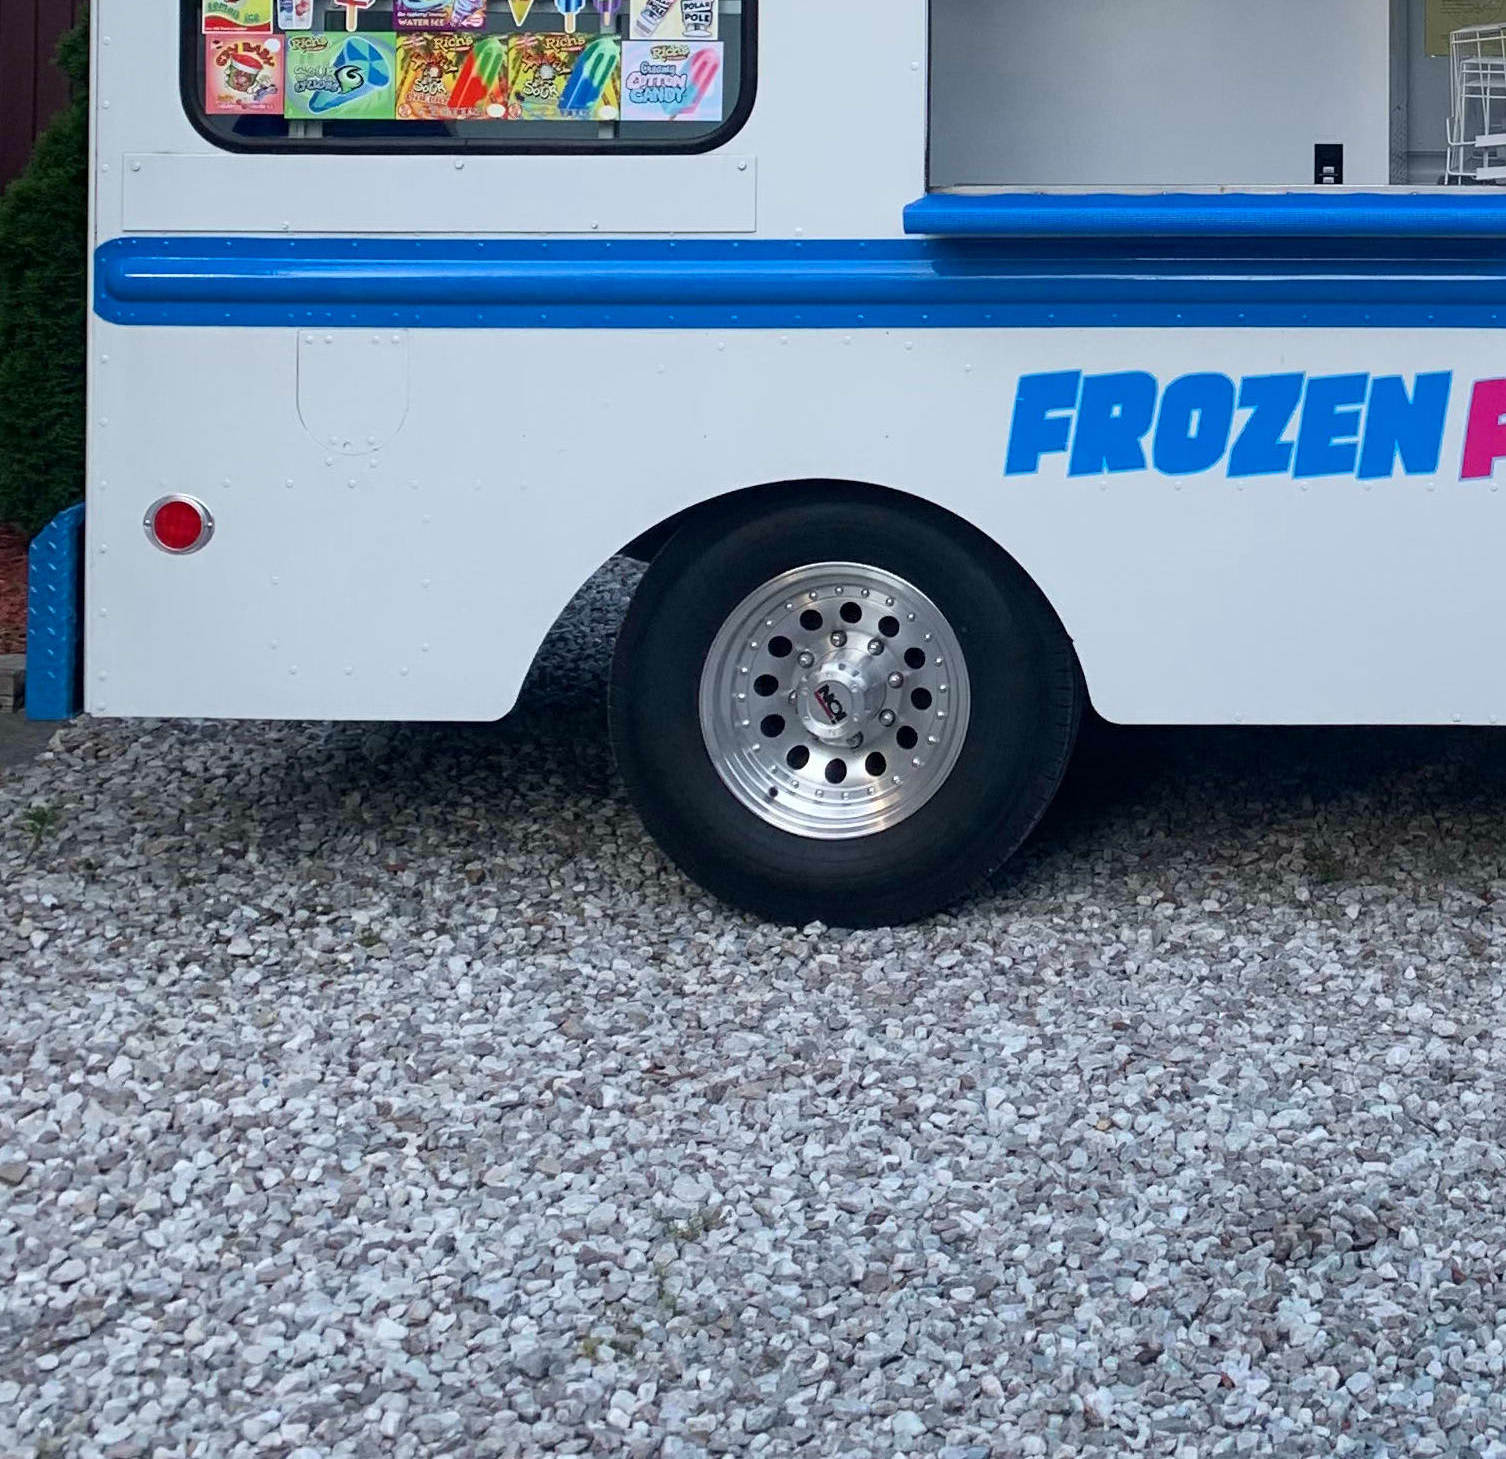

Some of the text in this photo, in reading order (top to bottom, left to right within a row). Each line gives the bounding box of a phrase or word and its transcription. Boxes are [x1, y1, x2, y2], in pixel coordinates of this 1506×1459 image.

[683, 2, 709, 11] POLAR
[685, 13, 709, 22] POLE
[433, 36, 473, 52] Rich's
[545, 36, 586, 52] Rich's
[629, 87, 687, 103] CANDY
[1003, 369, 1453, 478] FROZEN
